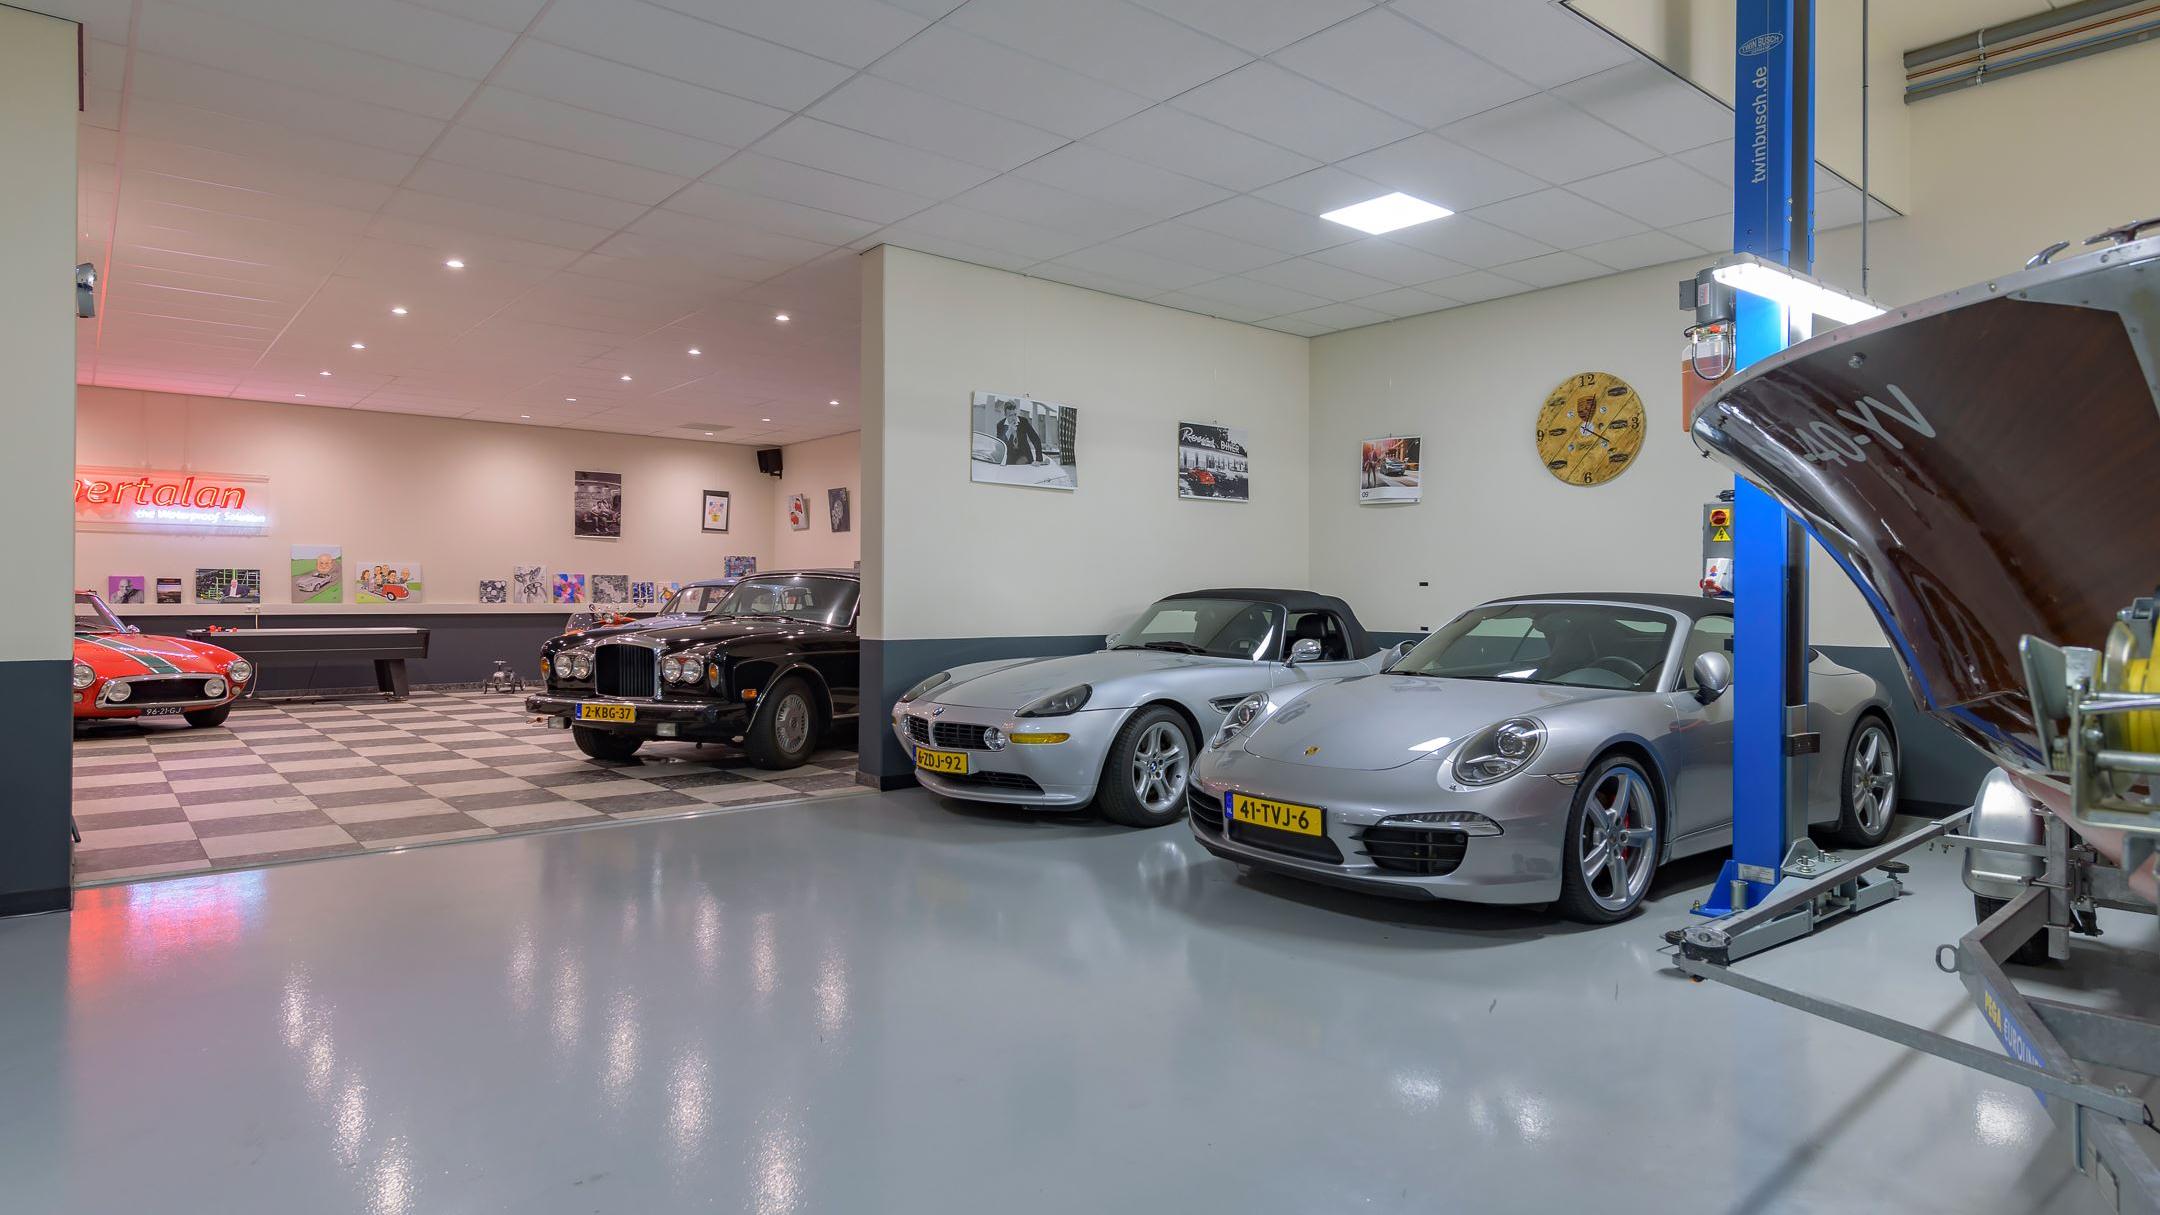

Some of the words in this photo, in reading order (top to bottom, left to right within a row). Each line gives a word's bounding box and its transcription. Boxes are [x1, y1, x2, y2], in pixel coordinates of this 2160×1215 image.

[1752, 66, 1767, 183] twinbusch.de
[1578, 374, 1595, 387] 12
[1631, 415, 1640, 429] 3
[1536, 429, 1544, 441] 9
[1583, 471, 1593, 483] 6
[585, 706, 631, 720] 2-KBG-37
[917, 750, 962, 771] 6-ZDJ-92
[1240, 800, 1310, 830] 41-TVJ-6
